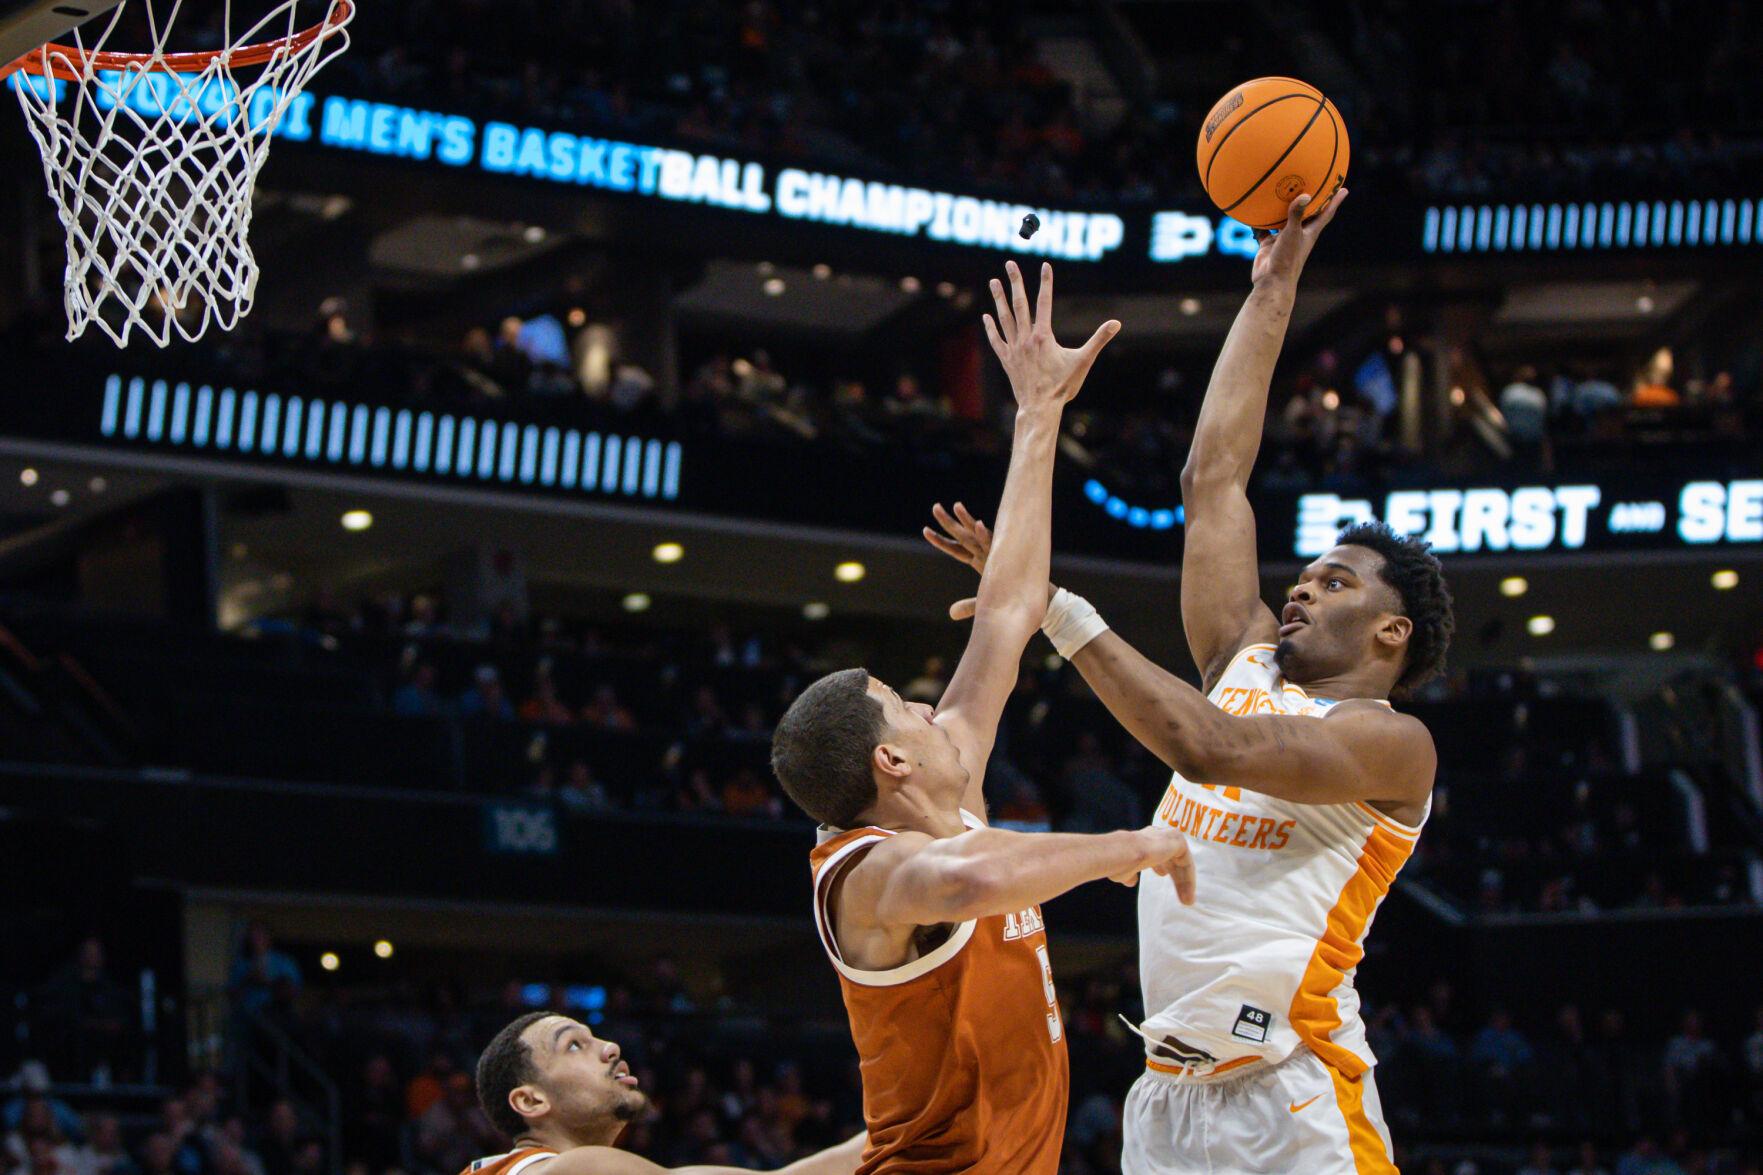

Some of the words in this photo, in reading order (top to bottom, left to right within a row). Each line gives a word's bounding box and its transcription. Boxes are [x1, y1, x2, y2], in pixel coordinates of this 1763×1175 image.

[321, 96, 475, 165] MEN'S
[480, 121, 771, 213] BASKETBALL
[775, 168, 1125, 261] CHAMPIONSHIP
[1384, 483, 1600, 553] FIRST
[1157, 783, 1297, 850] VOLUNTEERS
[1246, 1010, 1264, 1023] 48
